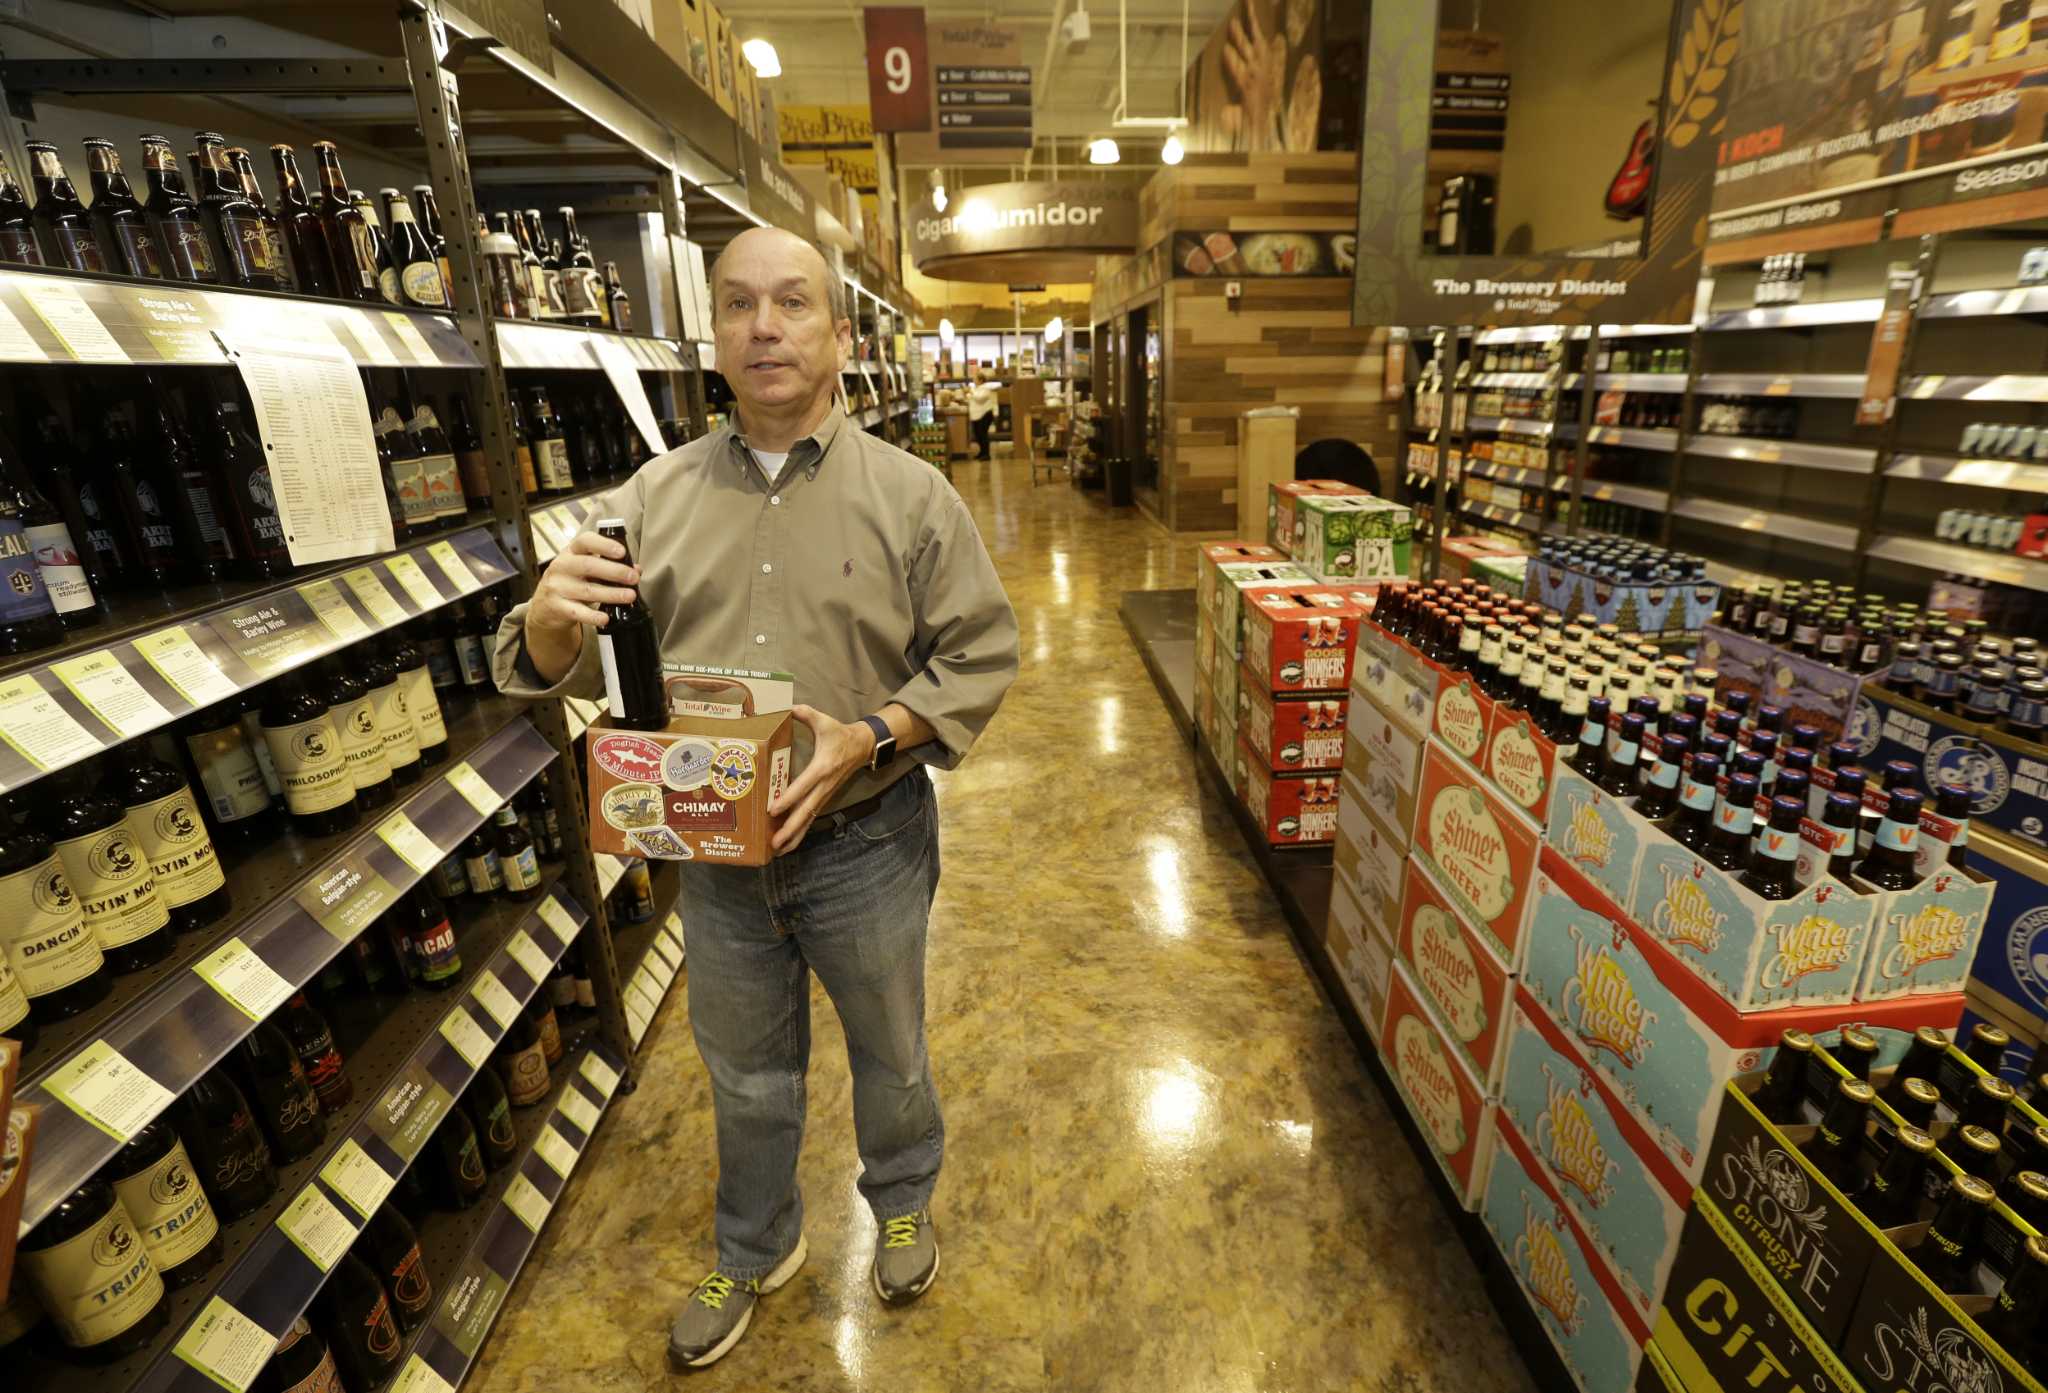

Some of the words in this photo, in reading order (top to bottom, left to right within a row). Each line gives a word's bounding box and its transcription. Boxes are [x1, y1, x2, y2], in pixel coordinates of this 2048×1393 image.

[884, 47, 912, 94] 9
[990, 202, 1104, 228] umidor
[1433, 279, 1471, 294] The
[1475, 279, 1556, 297] Brewery
[1561, 279, 1627, 295] District
[1354, 545, 1396, 577] IPA
[232, 614, 261, 628] Strong
[242, 624, 269, 639] Barley
[1304, 648, 1345, 657] GOOSE
[1302, 678, 1329, 688] ALE
[1303, 657, 1345, 679] HONKERS
[683, 702, 703, 712] Total
[711, 703, 731, 713] Wine
[1443, 700, 1478, 726] Shiner
[610, 740, 640, 749] Dogfish
[1303, 739, 1343, 758] HONKERS
[1444, 727, 1468, 750] CHEER
[611, 760, 646, 780] Minute
[650, 770, 661, 780] IP
[717, 748, 752, 770] NEWCASTLE
[1302, 759, 1327, 768] ALE
[1499, 742, 1538, 772] Shiner
[713, 775, 736, 796] BROWN
[737, 780, 749, 795] ALE
[1498, 772, 1527, 799] CHEER
[672, 802, 727, 813] CHIMAY
[700, 840, 746, 851] Brewery
[713, 835, 732, 843] The
[1299, 831, 1324, 841] ALE
[1440, 808, 1501, 866] Shiner
[705, 848, 743, 858] District
[320, 868, 349, 893] American
[321, 873, 362, 905] Belgian-style
[1442, 854, 1481, 906] CHEER
[1659, 864, 1728, 929] Winter
[1654, 900, 1727, 951] Cheers
[1766, 914, 1863, 952] Winter
[1887, 903, 1980, 943] Winter
[23, 922, 81, 957] DANCIN'
[1419, 924, 1477, 989] Shiner
[1760, 943, 1857, 990] Cheers
[1881, 934, 1969, 980] Cheers
[1568, 923, 1659, 1032] Winter
[1422, 966, 1460, 1025] CHEER
[1562, 977, 1655, 1066] Cheers
[1403, 1036, 1455, 1099] Shiner
[387, 1082, 413, 1112] American
[388, 1084, 423, 1124] Belgian-style
[1406, 1078, 1441, 1137] CHEER
[1541, 1062, 1621, 1180] Winter
[1535, 1111, 1616, 1207] Cheers
[1715, 1152, 1839, 1313] STONE
[1733, 1203, 1803, 1271] CITRUSY
[1520, 1190, 1590, 1316] Winter
[1765, 1251, 1793, 1280] WIT
[93, 1253, 150, 1305] TRIPE
